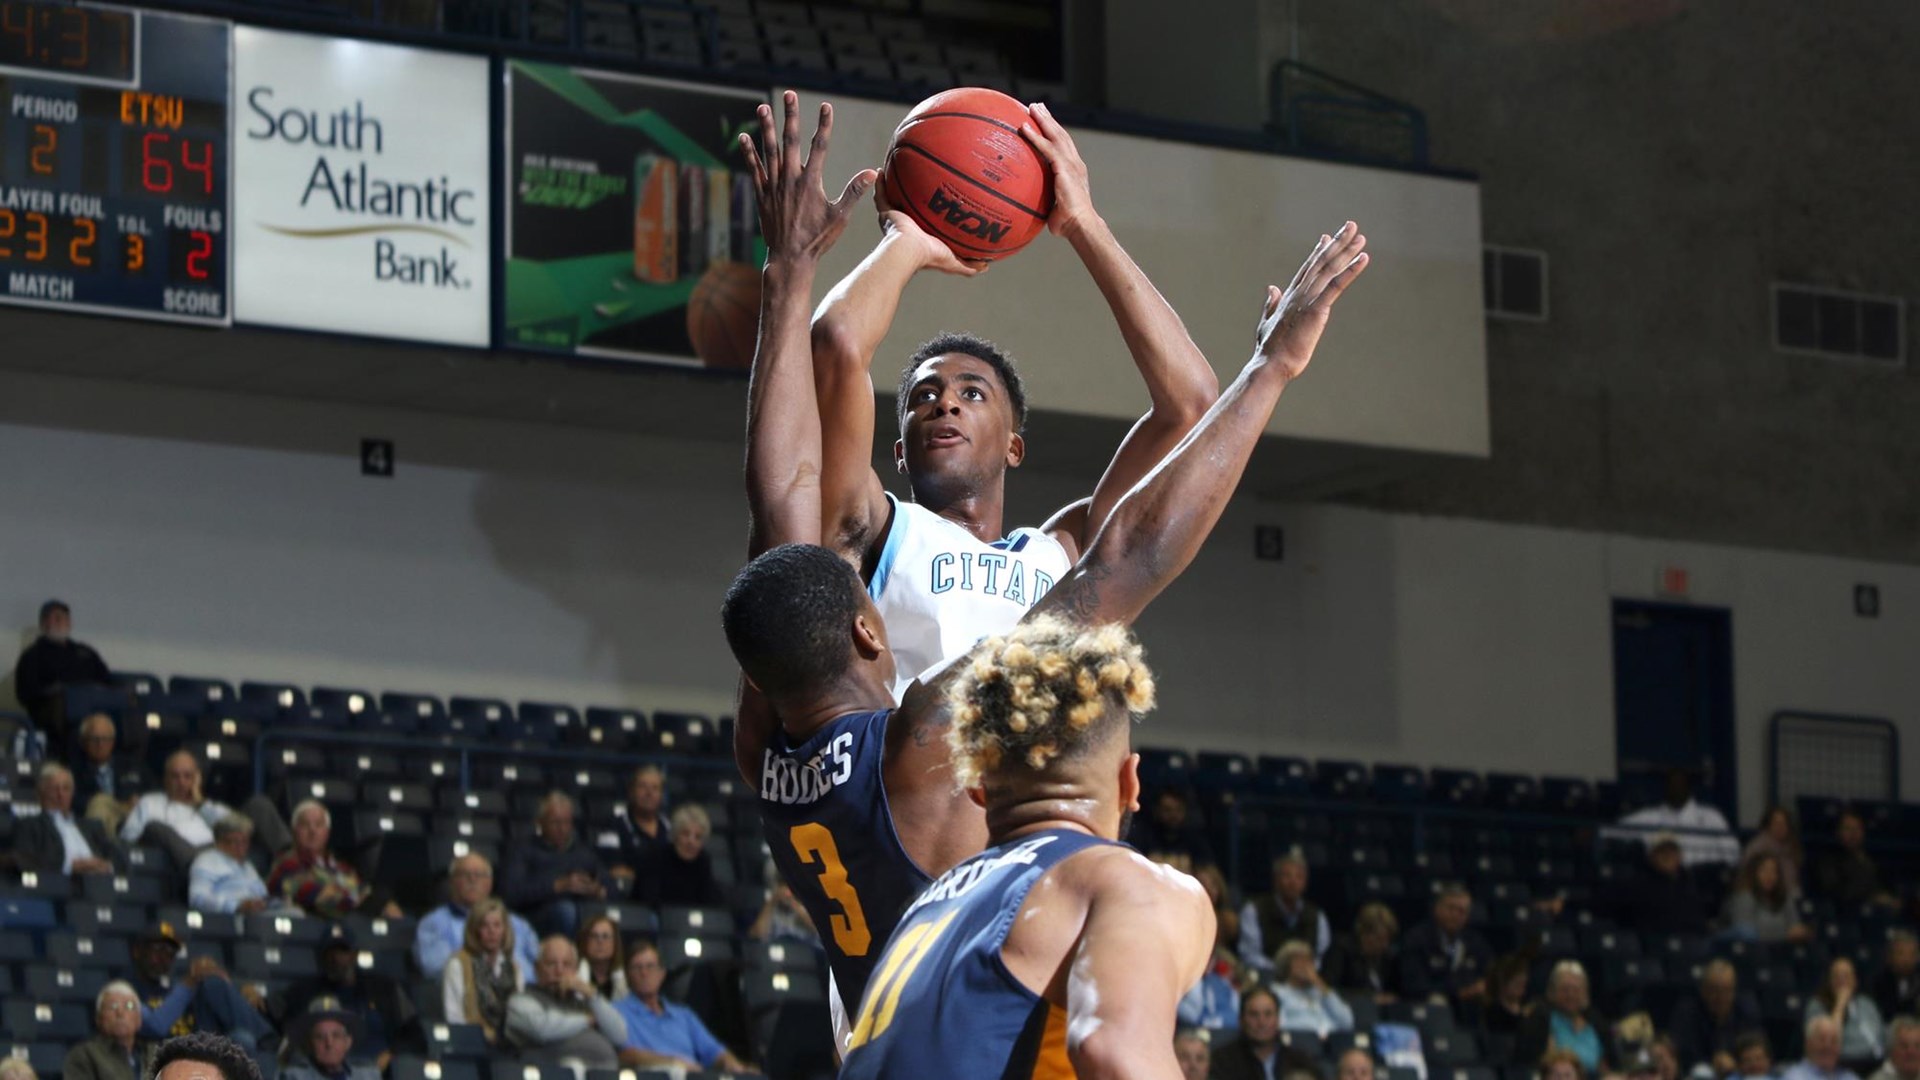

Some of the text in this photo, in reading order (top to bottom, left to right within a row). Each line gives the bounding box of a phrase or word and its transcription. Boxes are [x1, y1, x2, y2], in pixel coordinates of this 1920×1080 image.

[12, 94, 78, 122] PERIOD
[120, 91, 184, 129] ETSU
[247, 86, 383, 154] South
[31, 124, 57, 173] 2
[142, 131, 214, 194] 64
[59, 193, 105, 220] FOUL
[300, 156, 475, 226] Atlantic
[927, 187, 1012, 243] NCAA
[69, 217, 96, 267] 2
[163, 205, 222, 233] FOULS
[127, 233, 145, 270] 3
[186, 230, 213, 279] 2
[8, 271, 75, 300] MATCH
[162, 287, 222, 315] SCORE
[790, 822, 872, 956] 3
